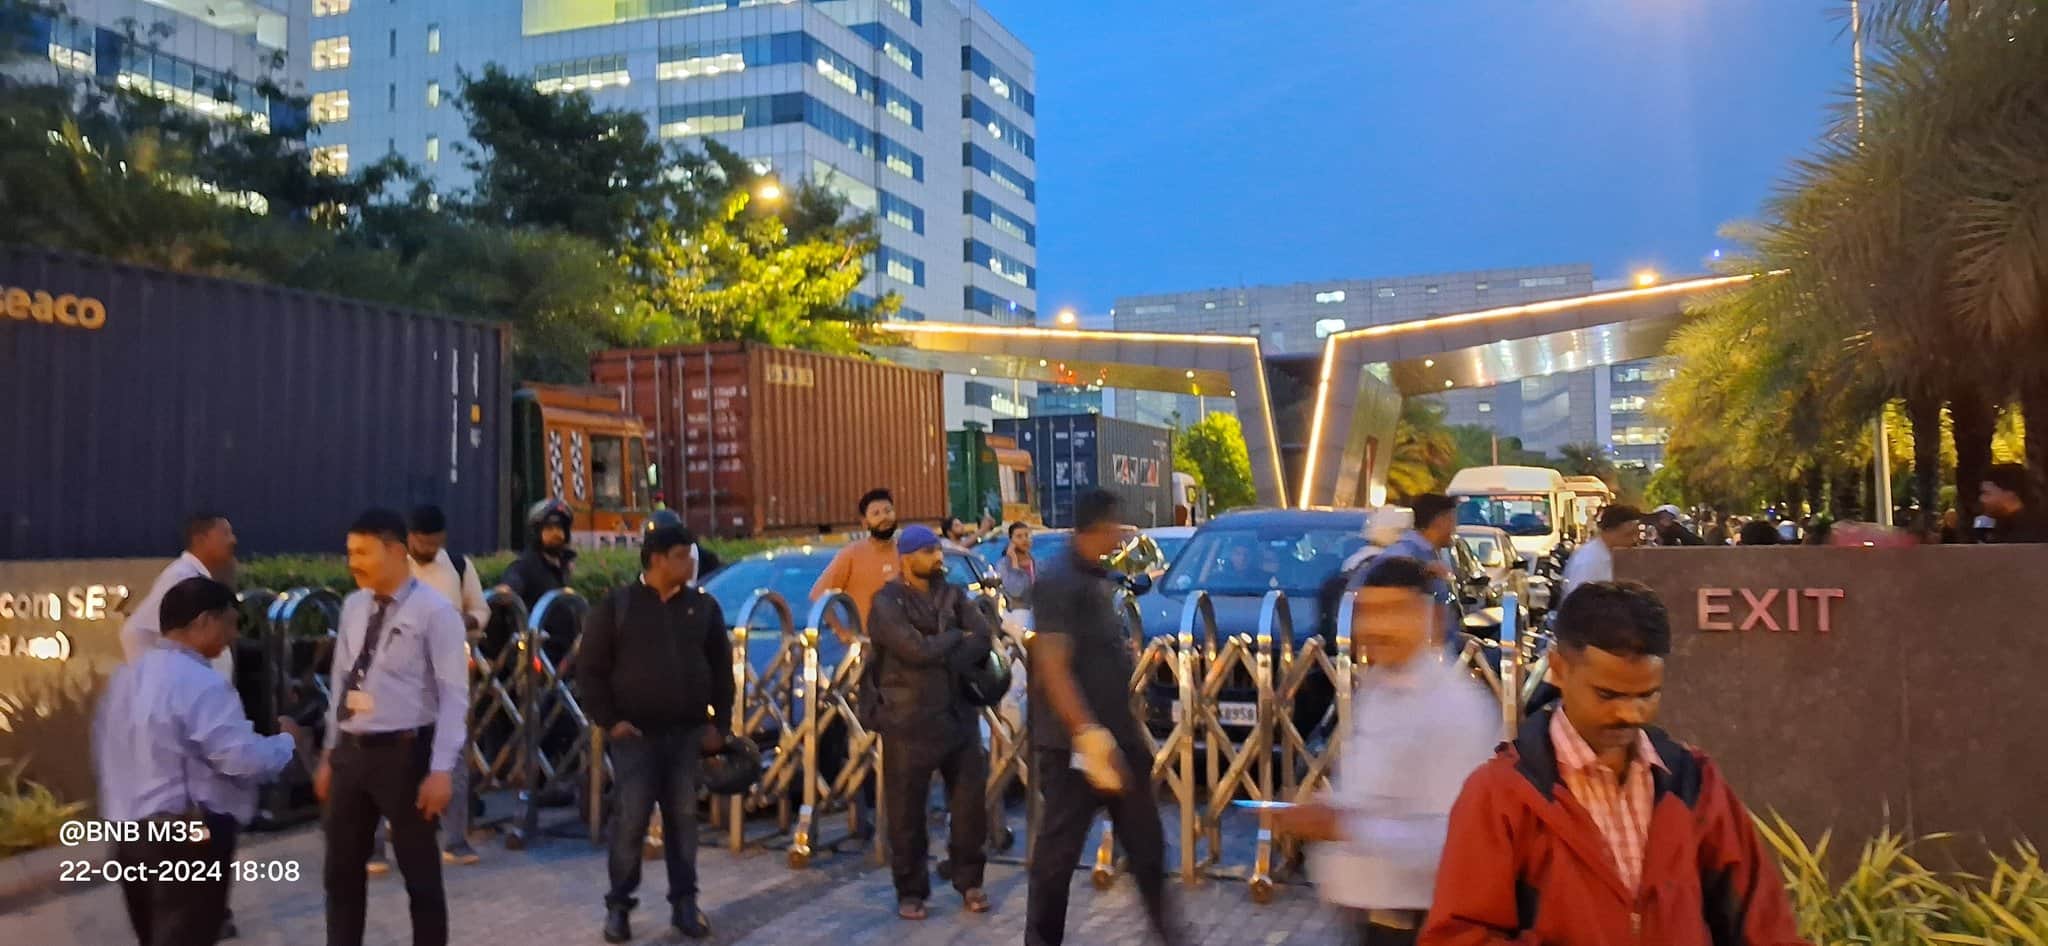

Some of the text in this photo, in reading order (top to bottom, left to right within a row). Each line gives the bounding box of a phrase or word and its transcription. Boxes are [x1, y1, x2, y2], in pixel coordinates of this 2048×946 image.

[0, 285, 106, 329] eaco
[67, 584, 129, 620] SEZ
[1697, 588, 1844, 631] EXIT
